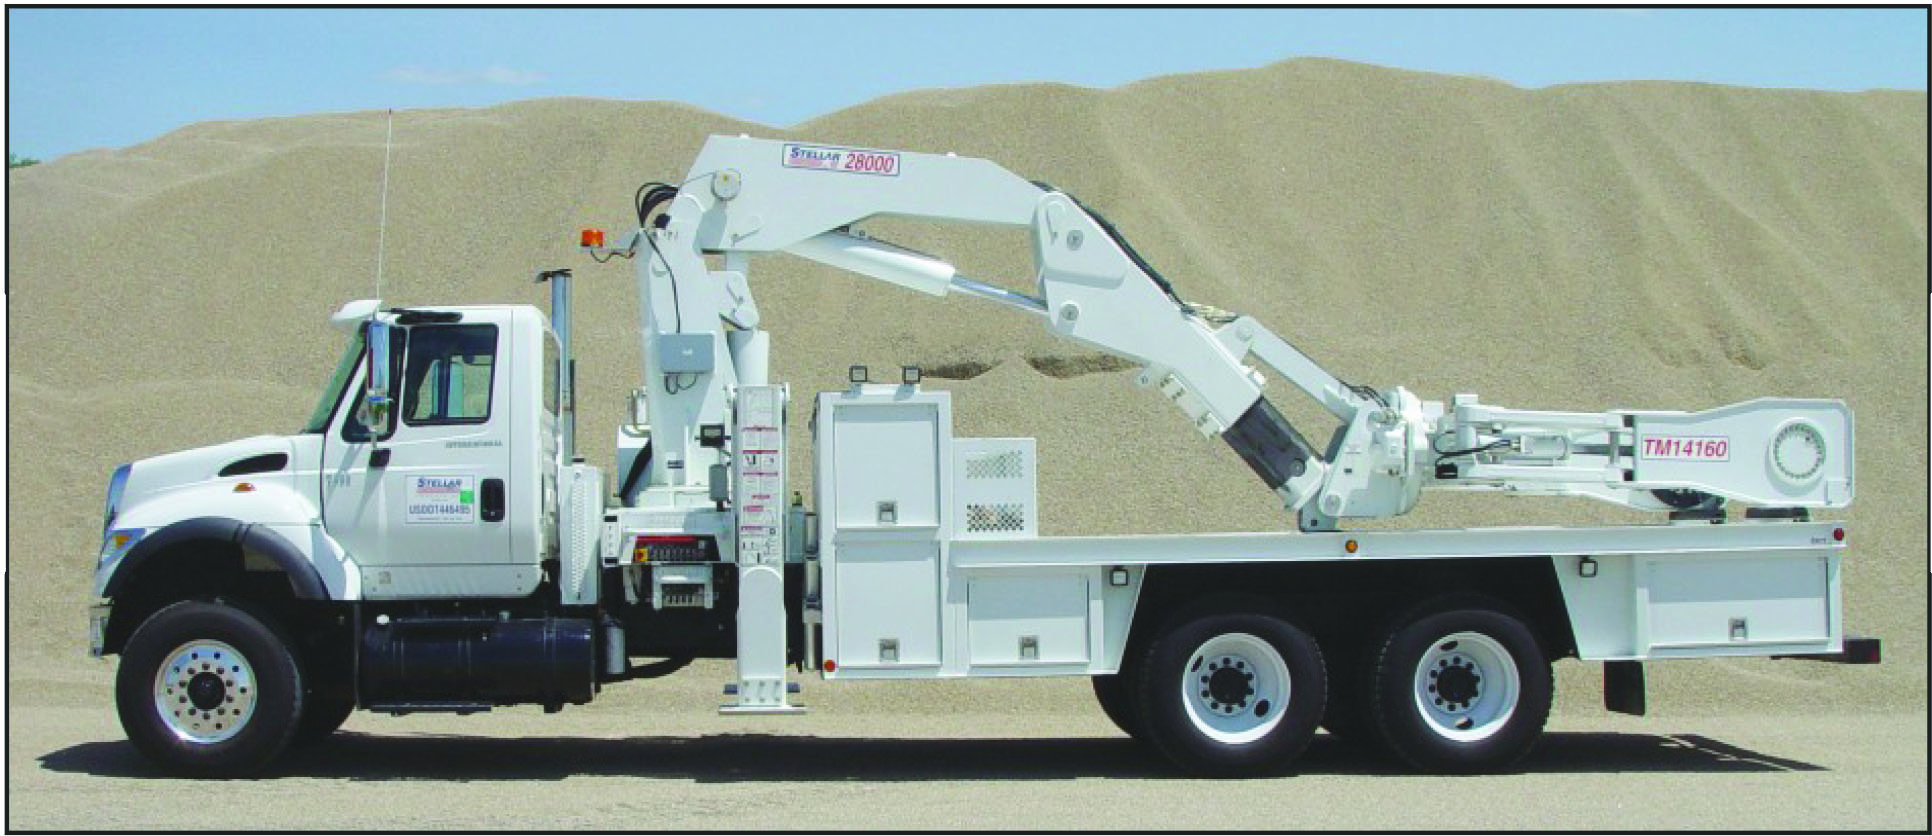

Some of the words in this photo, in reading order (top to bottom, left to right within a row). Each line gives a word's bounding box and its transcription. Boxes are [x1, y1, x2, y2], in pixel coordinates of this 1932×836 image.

[790, 147, 841, 161] STELLAR
[845, 153, 895, 173] 28000
[1644, 439, 1727, 457] TM14160
[417, 478, 462, 488] STELLAR
